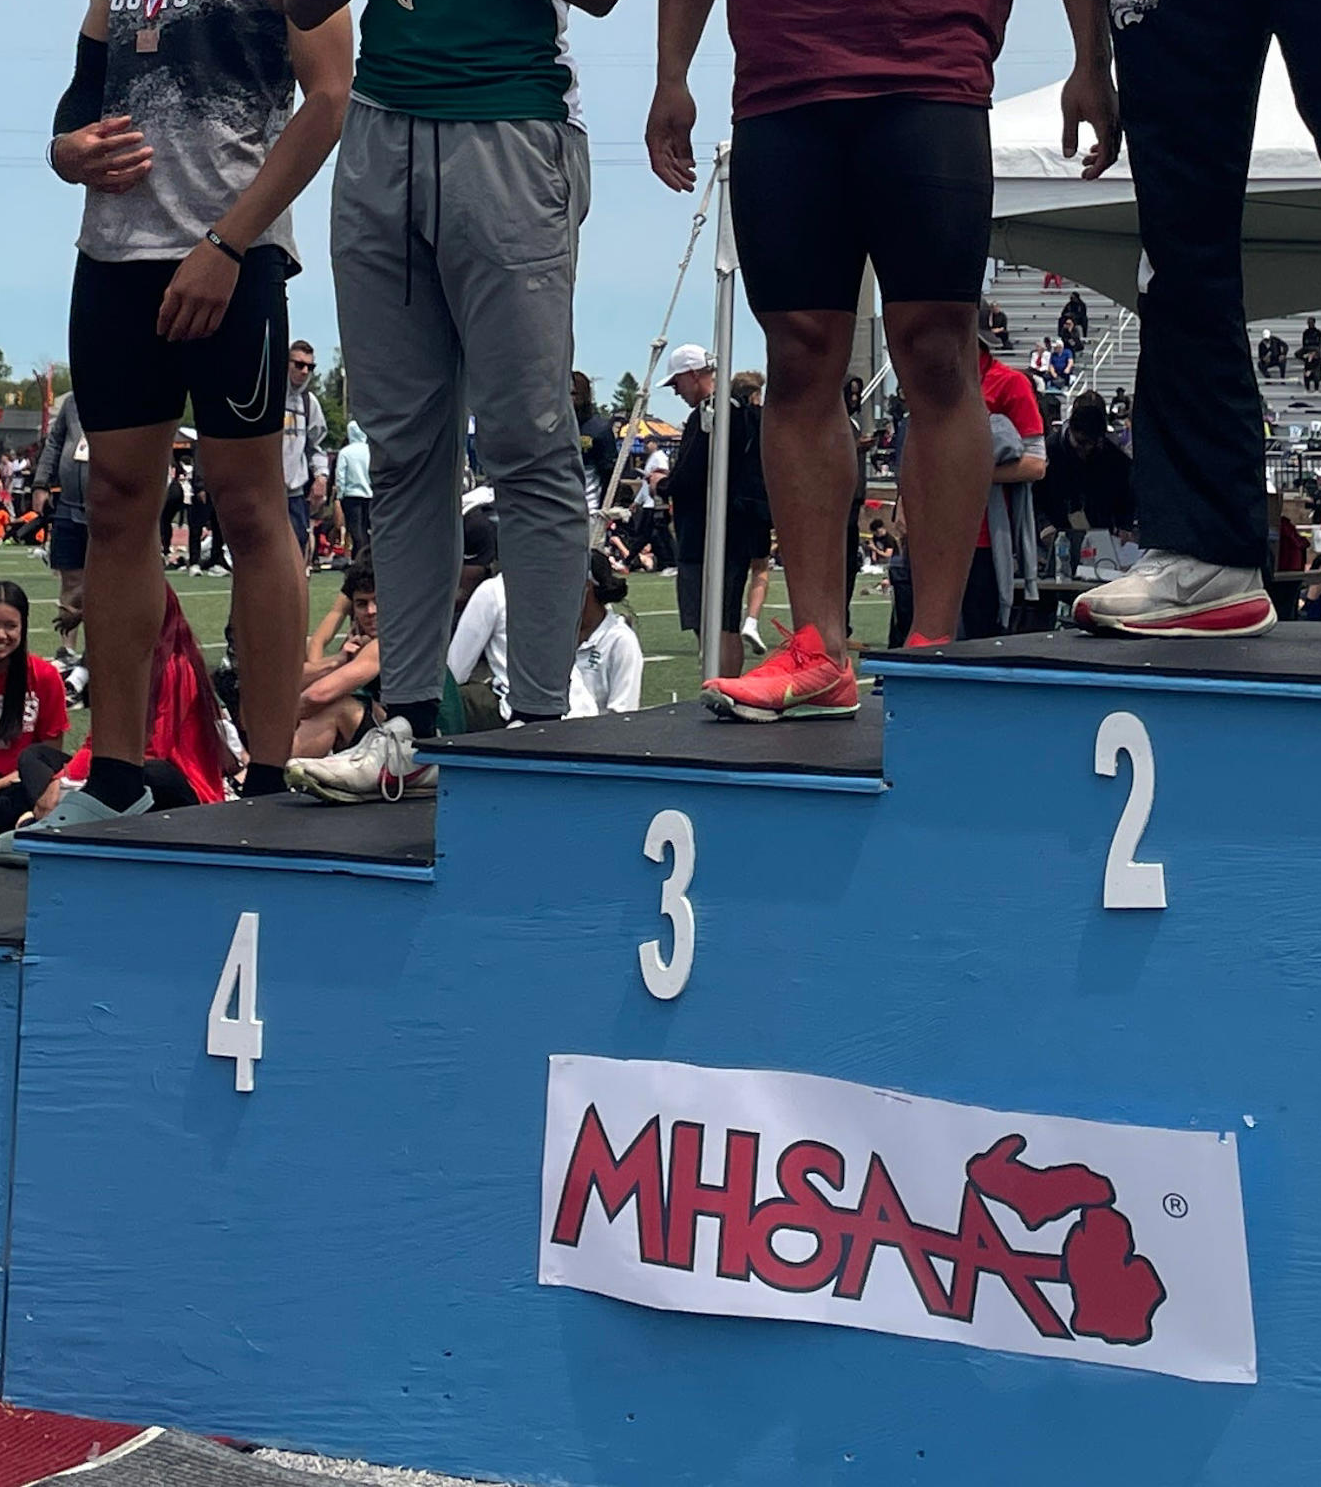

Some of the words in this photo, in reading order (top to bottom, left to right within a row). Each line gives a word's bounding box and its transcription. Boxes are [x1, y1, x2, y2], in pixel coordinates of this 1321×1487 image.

[638, 809, 696, 1001] 3
[1094, 712, 1167, 909] 2
[207, 912, 263, 1092] 4
[550, 1102, 1076, 1341] MHSAA
